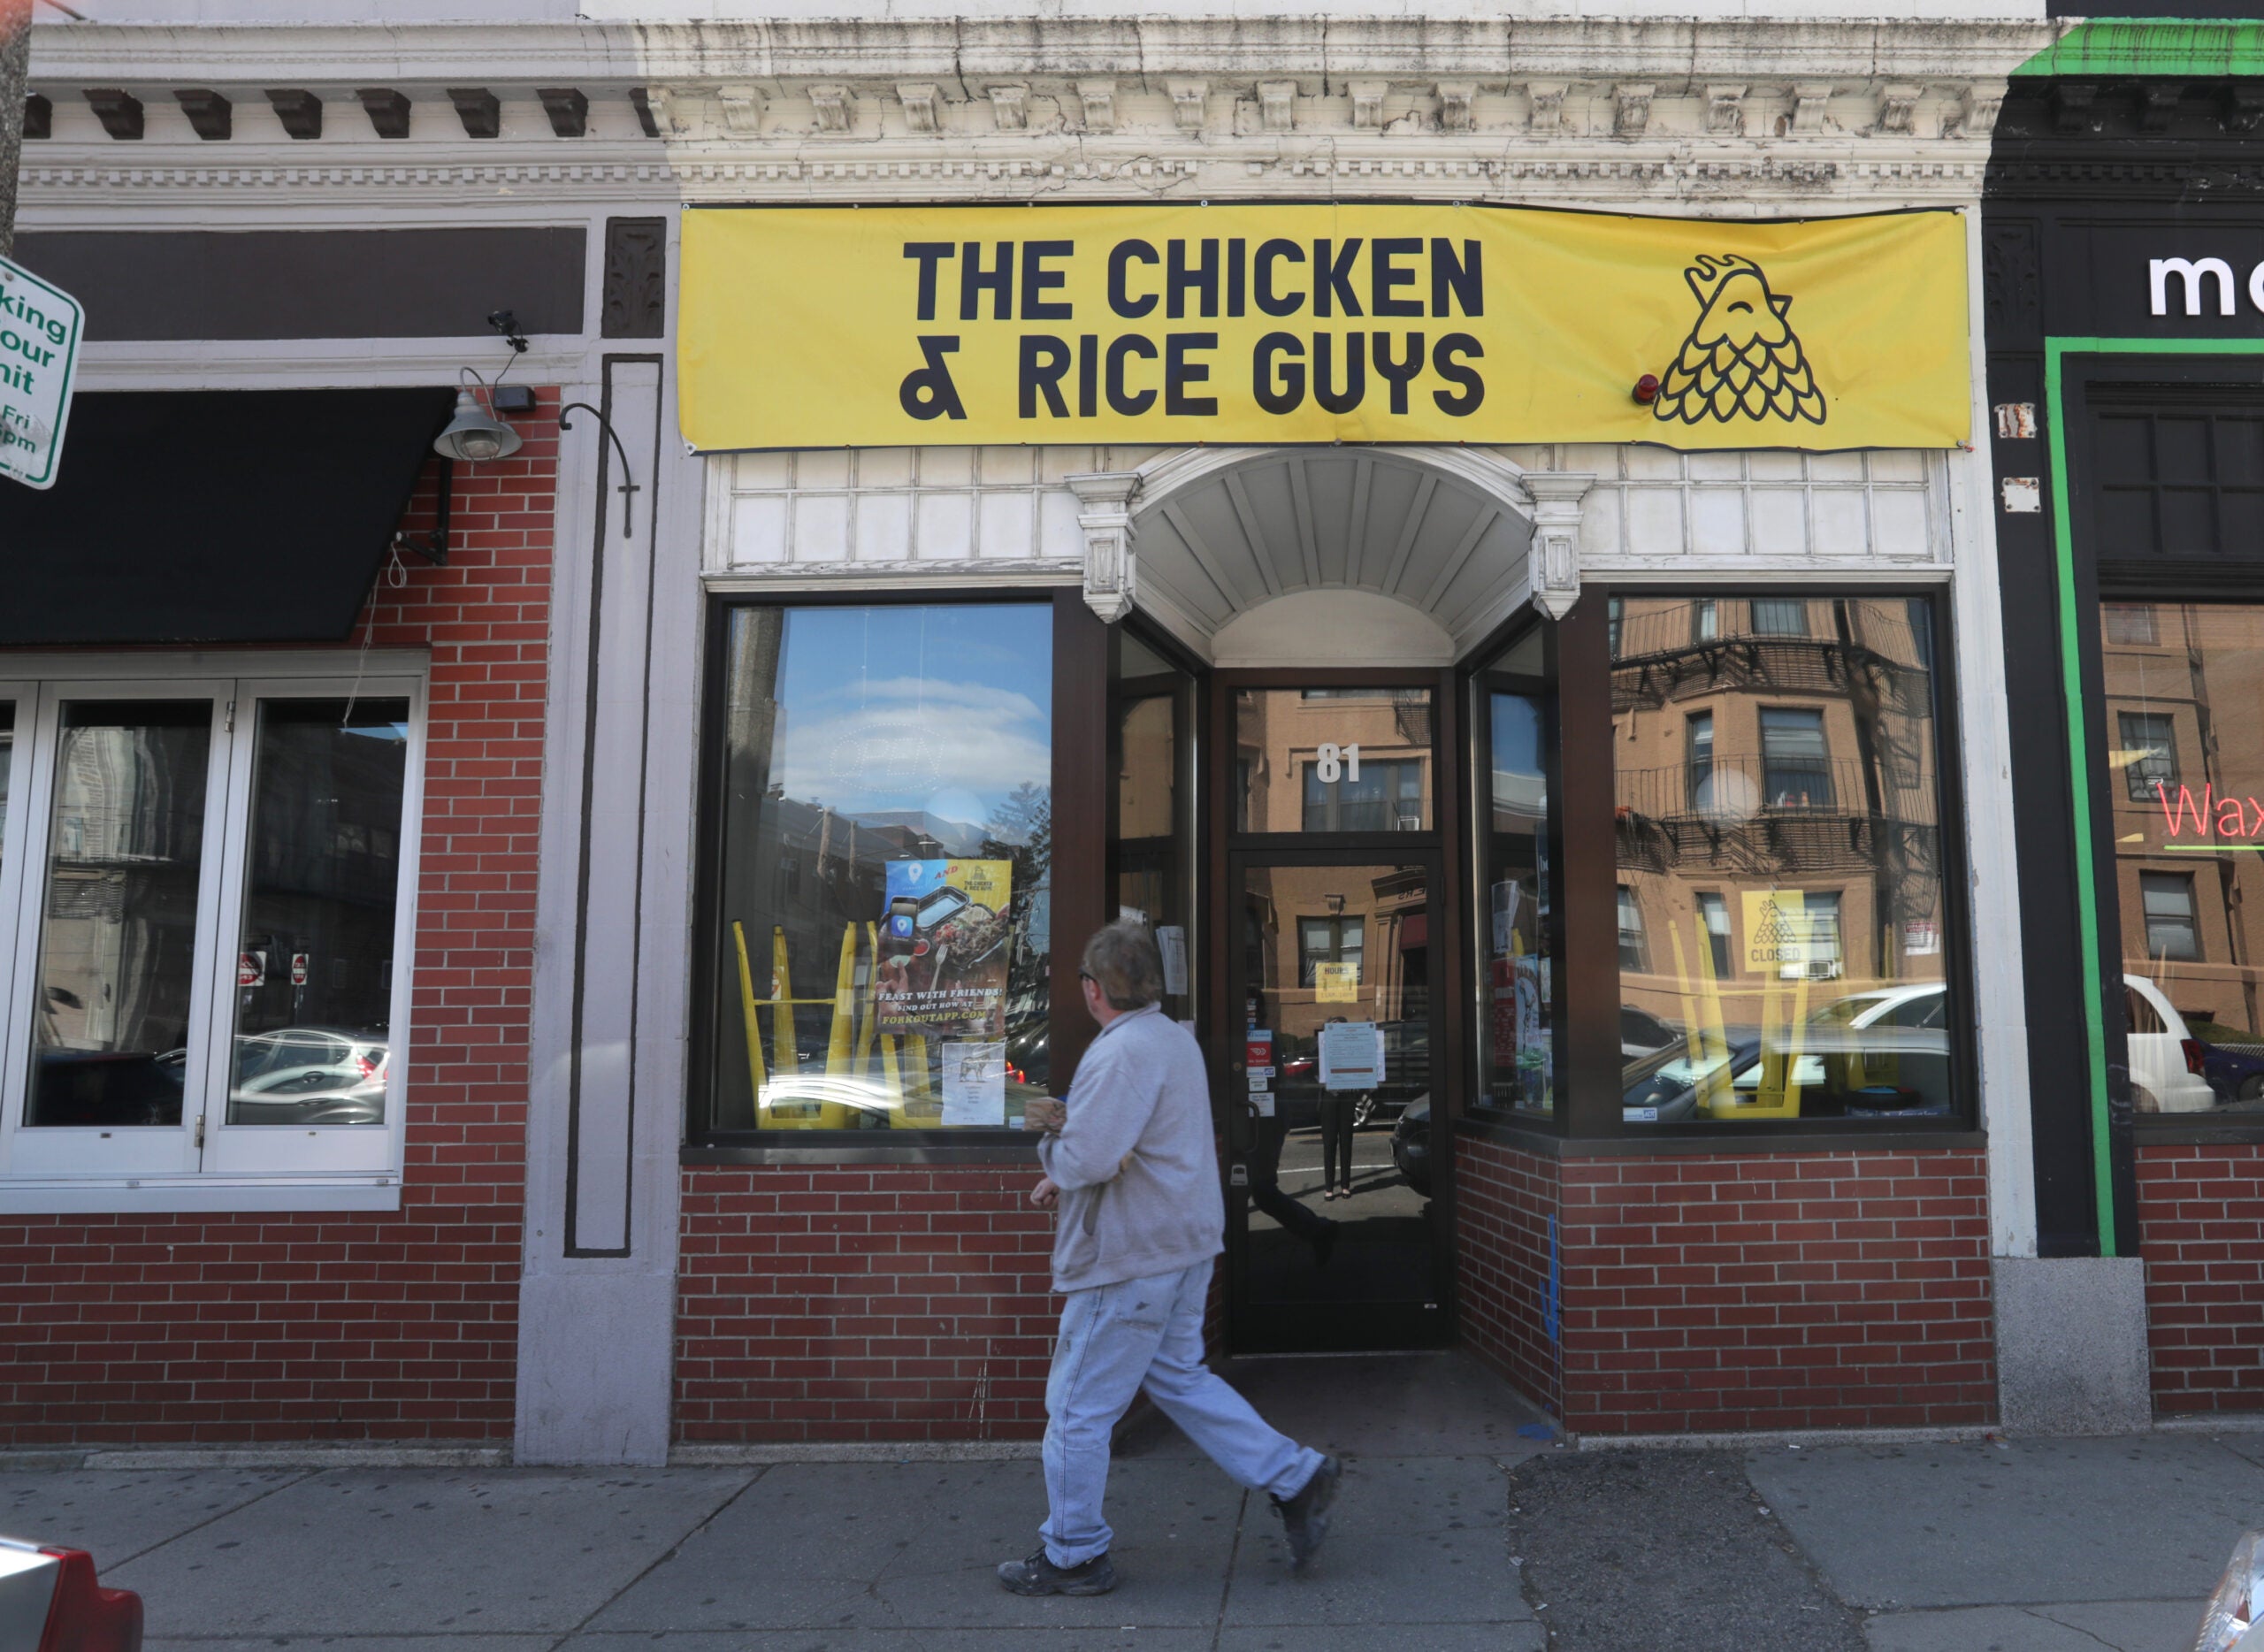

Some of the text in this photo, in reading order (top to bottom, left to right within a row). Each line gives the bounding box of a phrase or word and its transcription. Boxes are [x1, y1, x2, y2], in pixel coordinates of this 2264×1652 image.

[903, 237, 1485, 320] THE CHICKEN
[899, 331, 1485, 420] & RICE GUYS
[2, 404, 30, 430] Fri
[830, 738, 946, 777] OPEN
[1316, 742, 1360, 784] 81
[934, 866, 959, 880] AND
[1751, 947, 1801, 963] CLOSED
[878, 988, 1003, 1001] FEAST WITH FRIENDS!
[882, 1010, 988, 1024] FORKOUTAPP.COM
